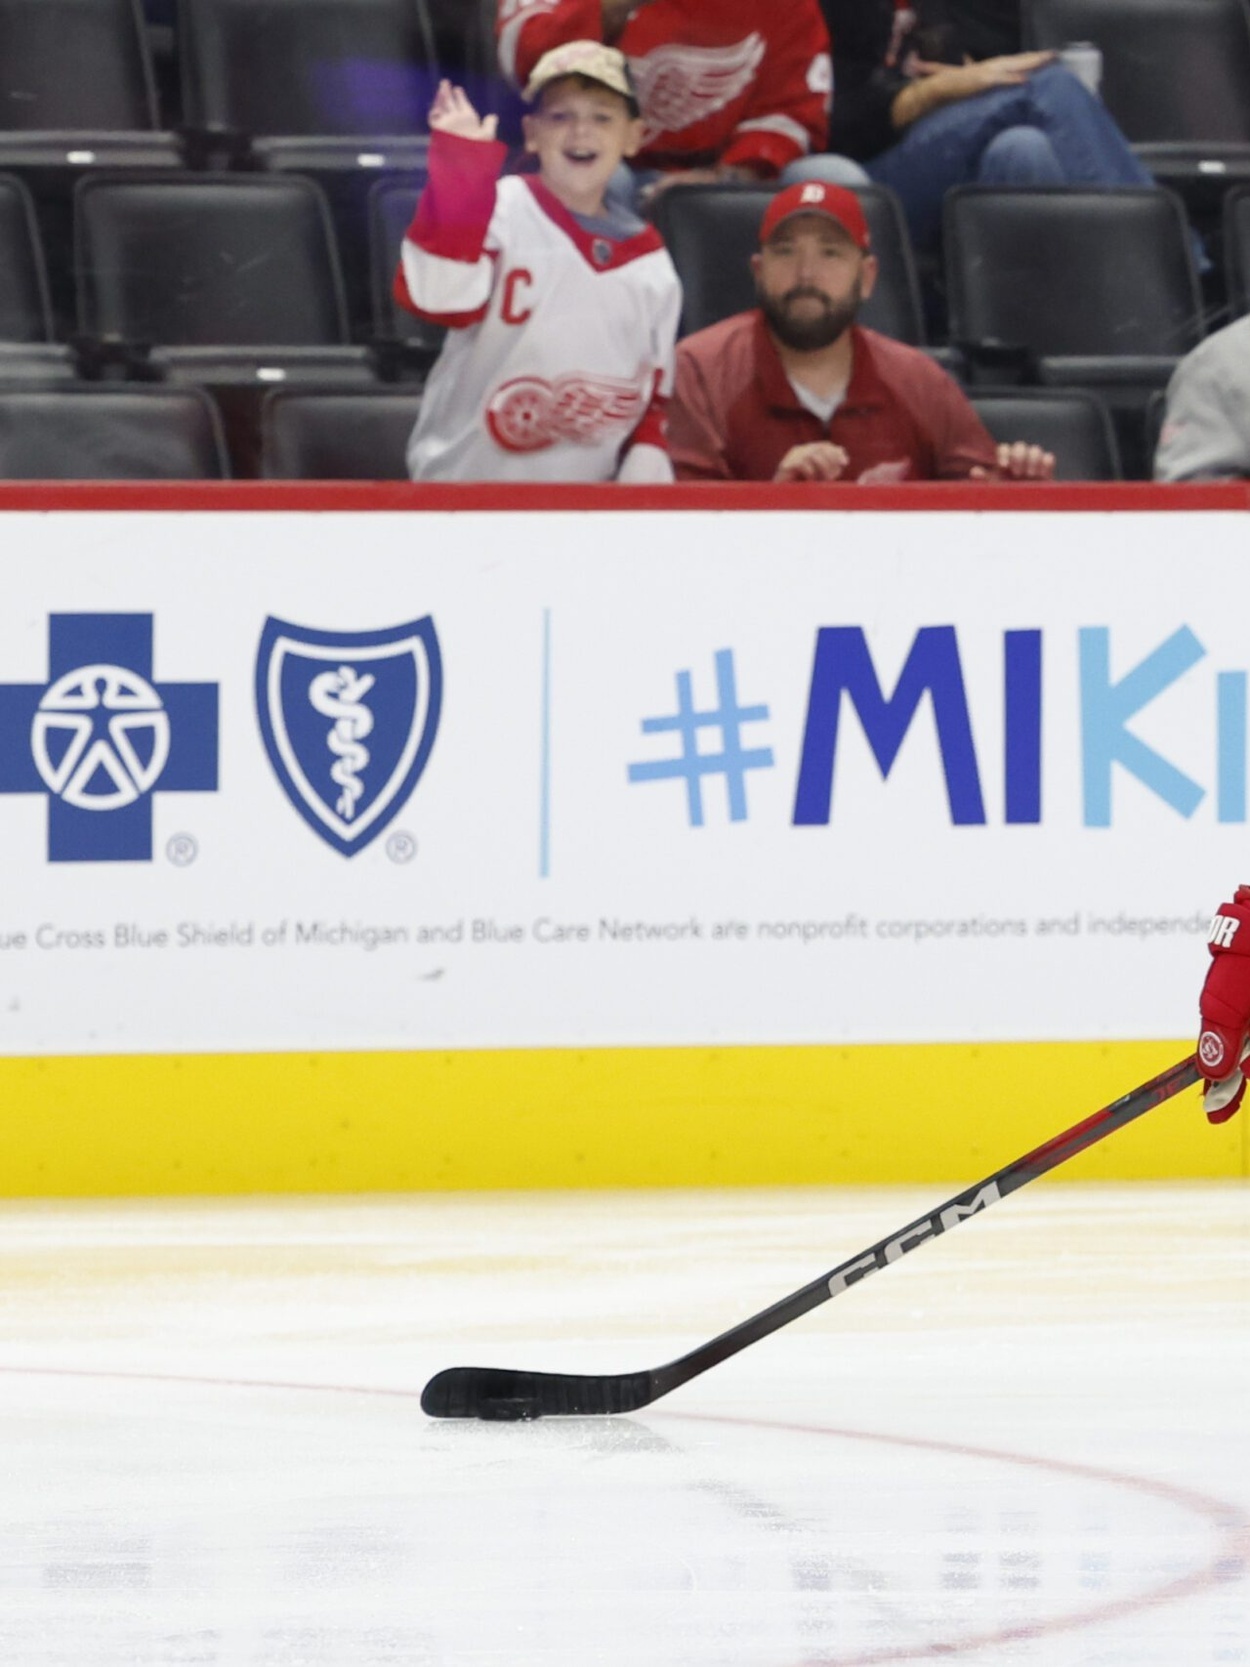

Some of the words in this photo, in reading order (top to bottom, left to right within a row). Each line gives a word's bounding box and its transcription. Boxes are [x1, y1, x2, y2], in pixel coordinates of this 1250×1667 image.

[502, 268, 533, 326] C
[35, 923, 106, 949] Cross
[114, 923, 169, 948] Blue
[177, 922, 254, 947] Shield
[261, 920, 287, 946] of
[295, 922, 409, 951] Michigan
[416, 920, 464, 943] and
[471, 919, 525, 942] Blue
[532, 918, 591, 943] Care
[599, 919, 702, 941] Network
[712, 921, 749, 939] are
[758, 914, 868, 943] nonprofit
[876, 918, 1028, 939] corporations
[1035, 914, 1080, 935] and
[1088, 912, 1212, 937] independe
[828, 1181, 1001, 1298] CCM
